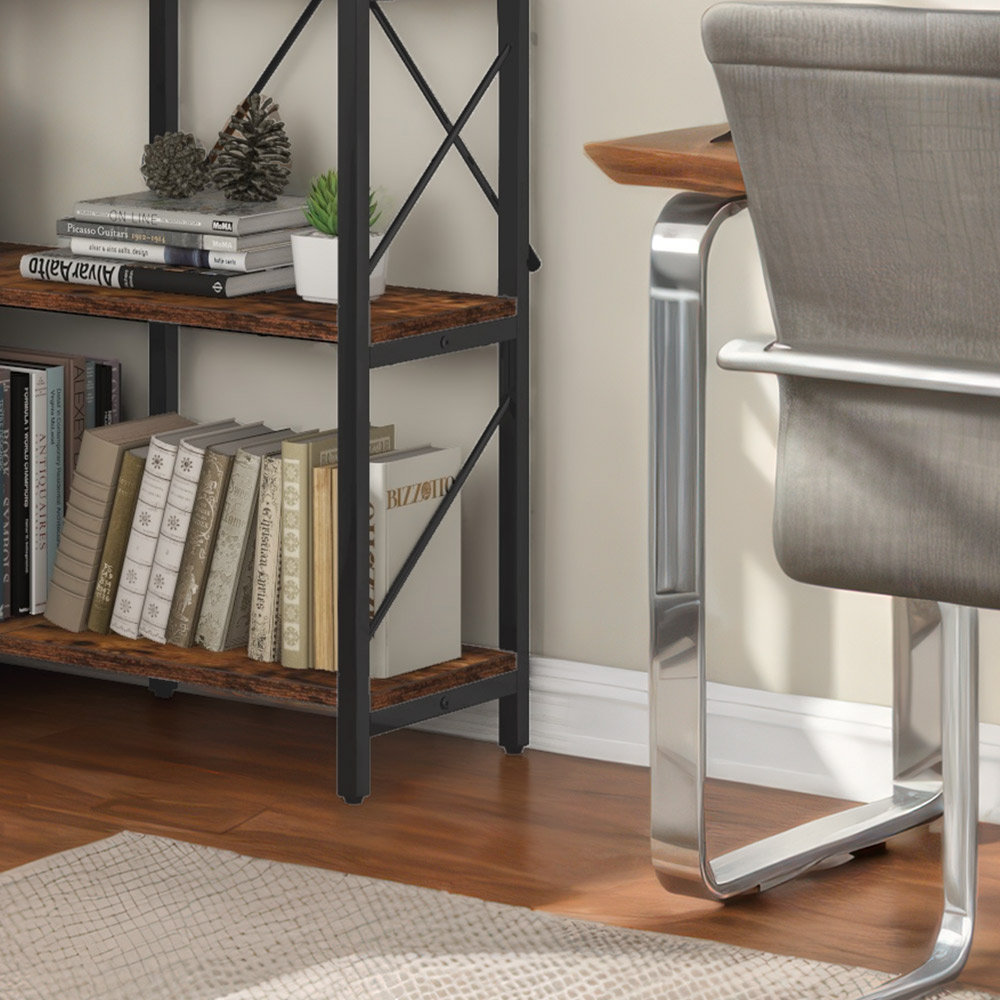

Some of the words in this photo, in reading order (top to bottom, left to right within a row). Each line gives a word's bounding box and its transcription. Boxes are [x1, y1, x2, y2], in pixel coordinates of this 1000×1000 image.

[110, 210, 126, 223] ON
[67, 223, 96, 236] Picasso
[97, 227, 129, 239] Guitars
[212, 220, 233, 231] MoMA
[212, 240, 232, 249] MoMA
[73, 366, 85, 442] ALEXEY
[38, 433, 47, 551] ANTIQUAIRES
[387, 476, 455, 510] BIZZOTTO
